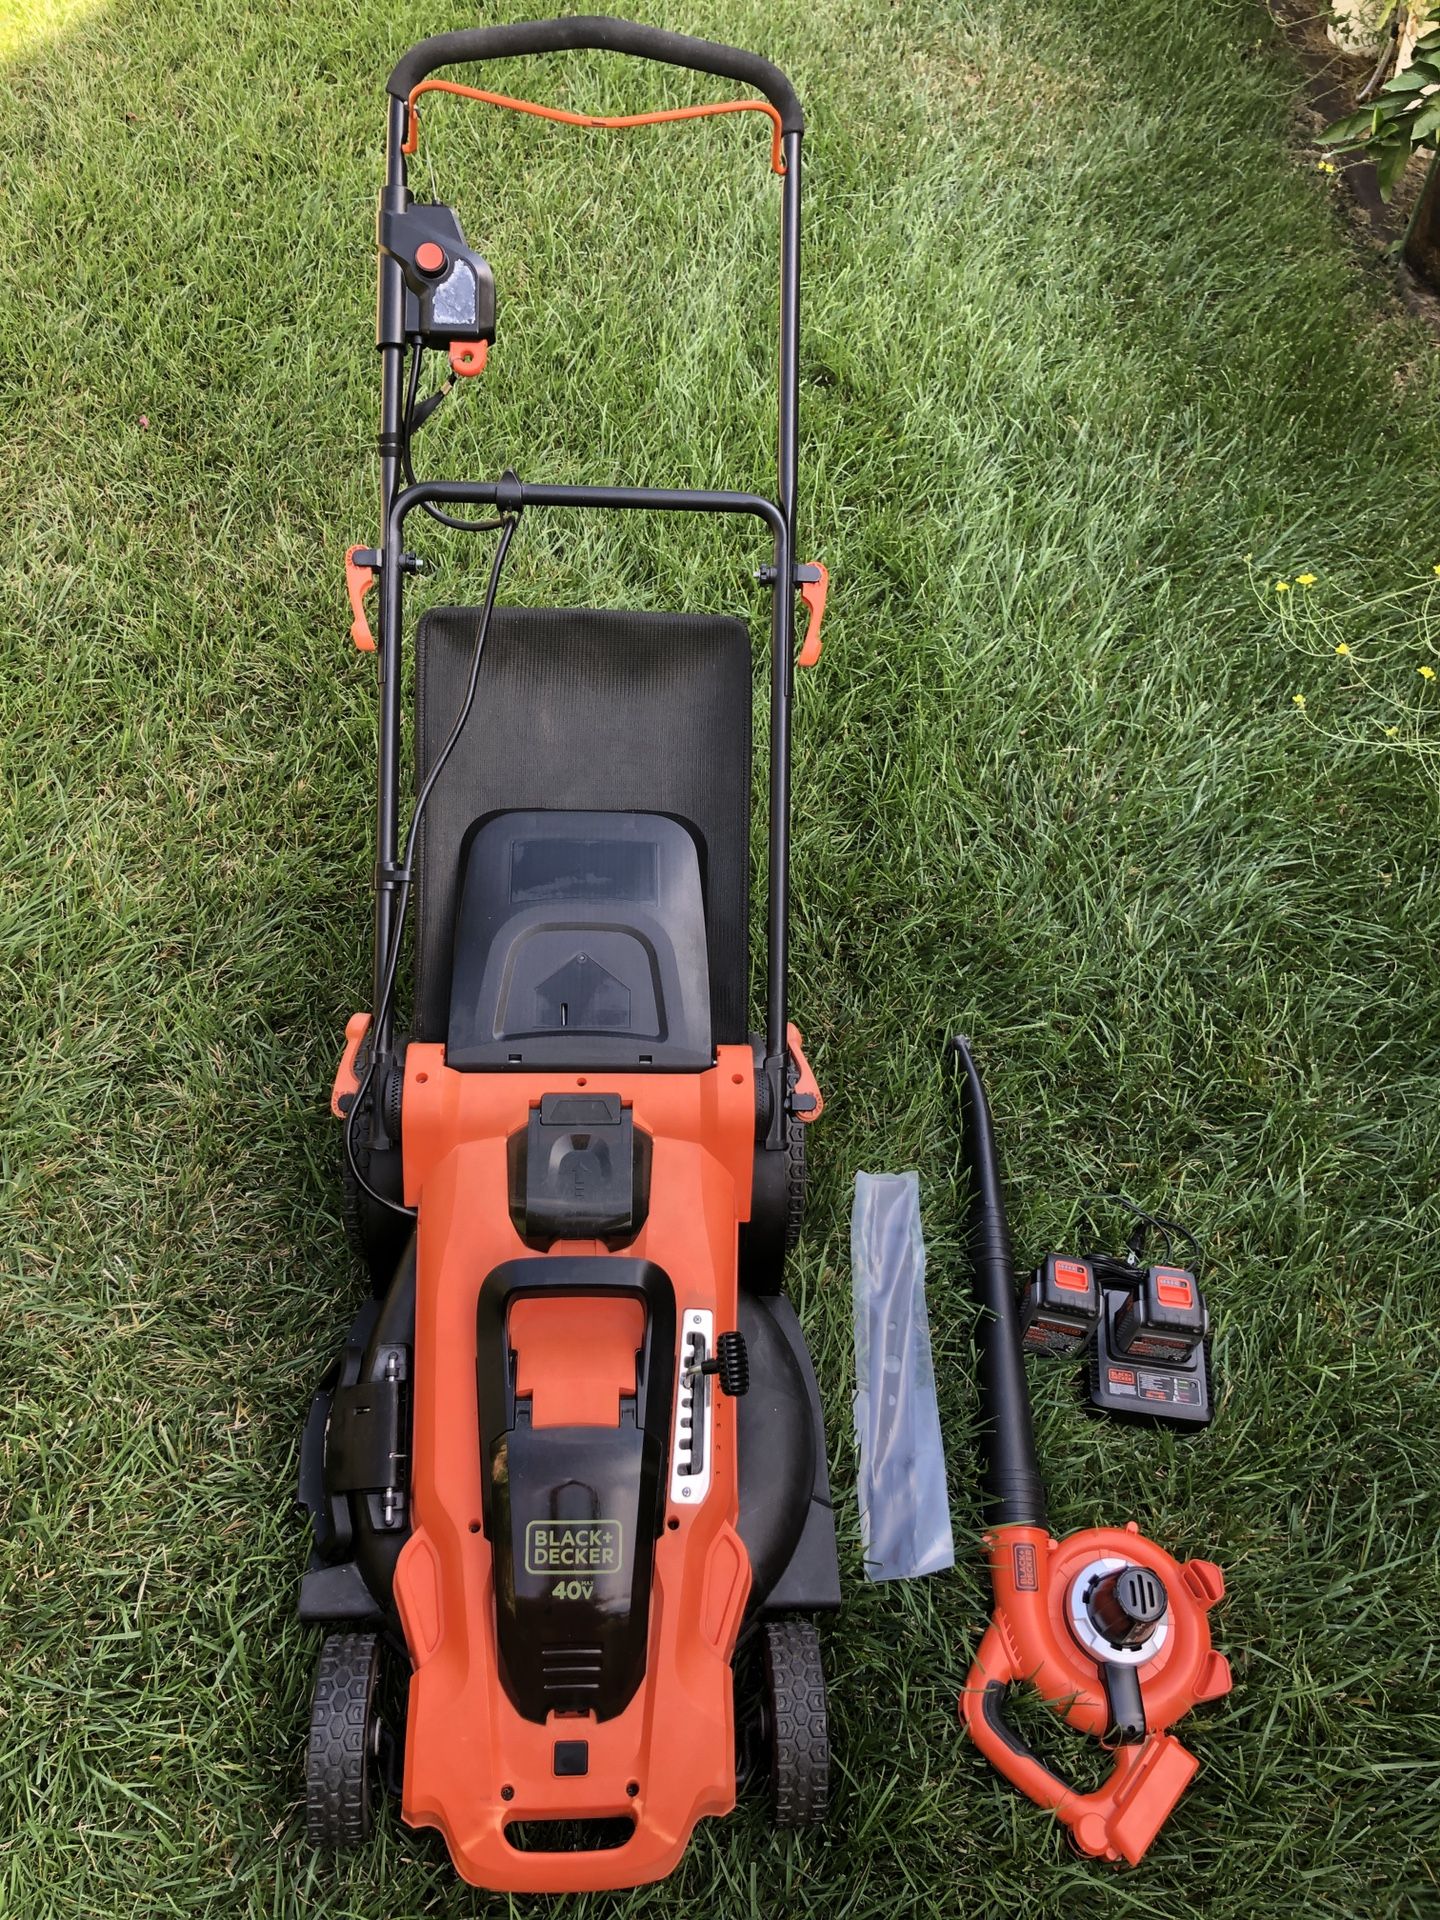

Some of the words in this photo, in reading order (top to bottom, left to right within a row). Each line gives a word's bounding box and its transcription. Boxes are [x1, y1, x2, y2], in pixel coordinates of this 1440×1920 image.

[535, 1530, 613, 1546] BLACK+
[534, 1549, 613, 1564] DECKER
[1018, 1550, 1027, 1585] BLACK+
[1026, 1549, 1034, 1585] DECKER
